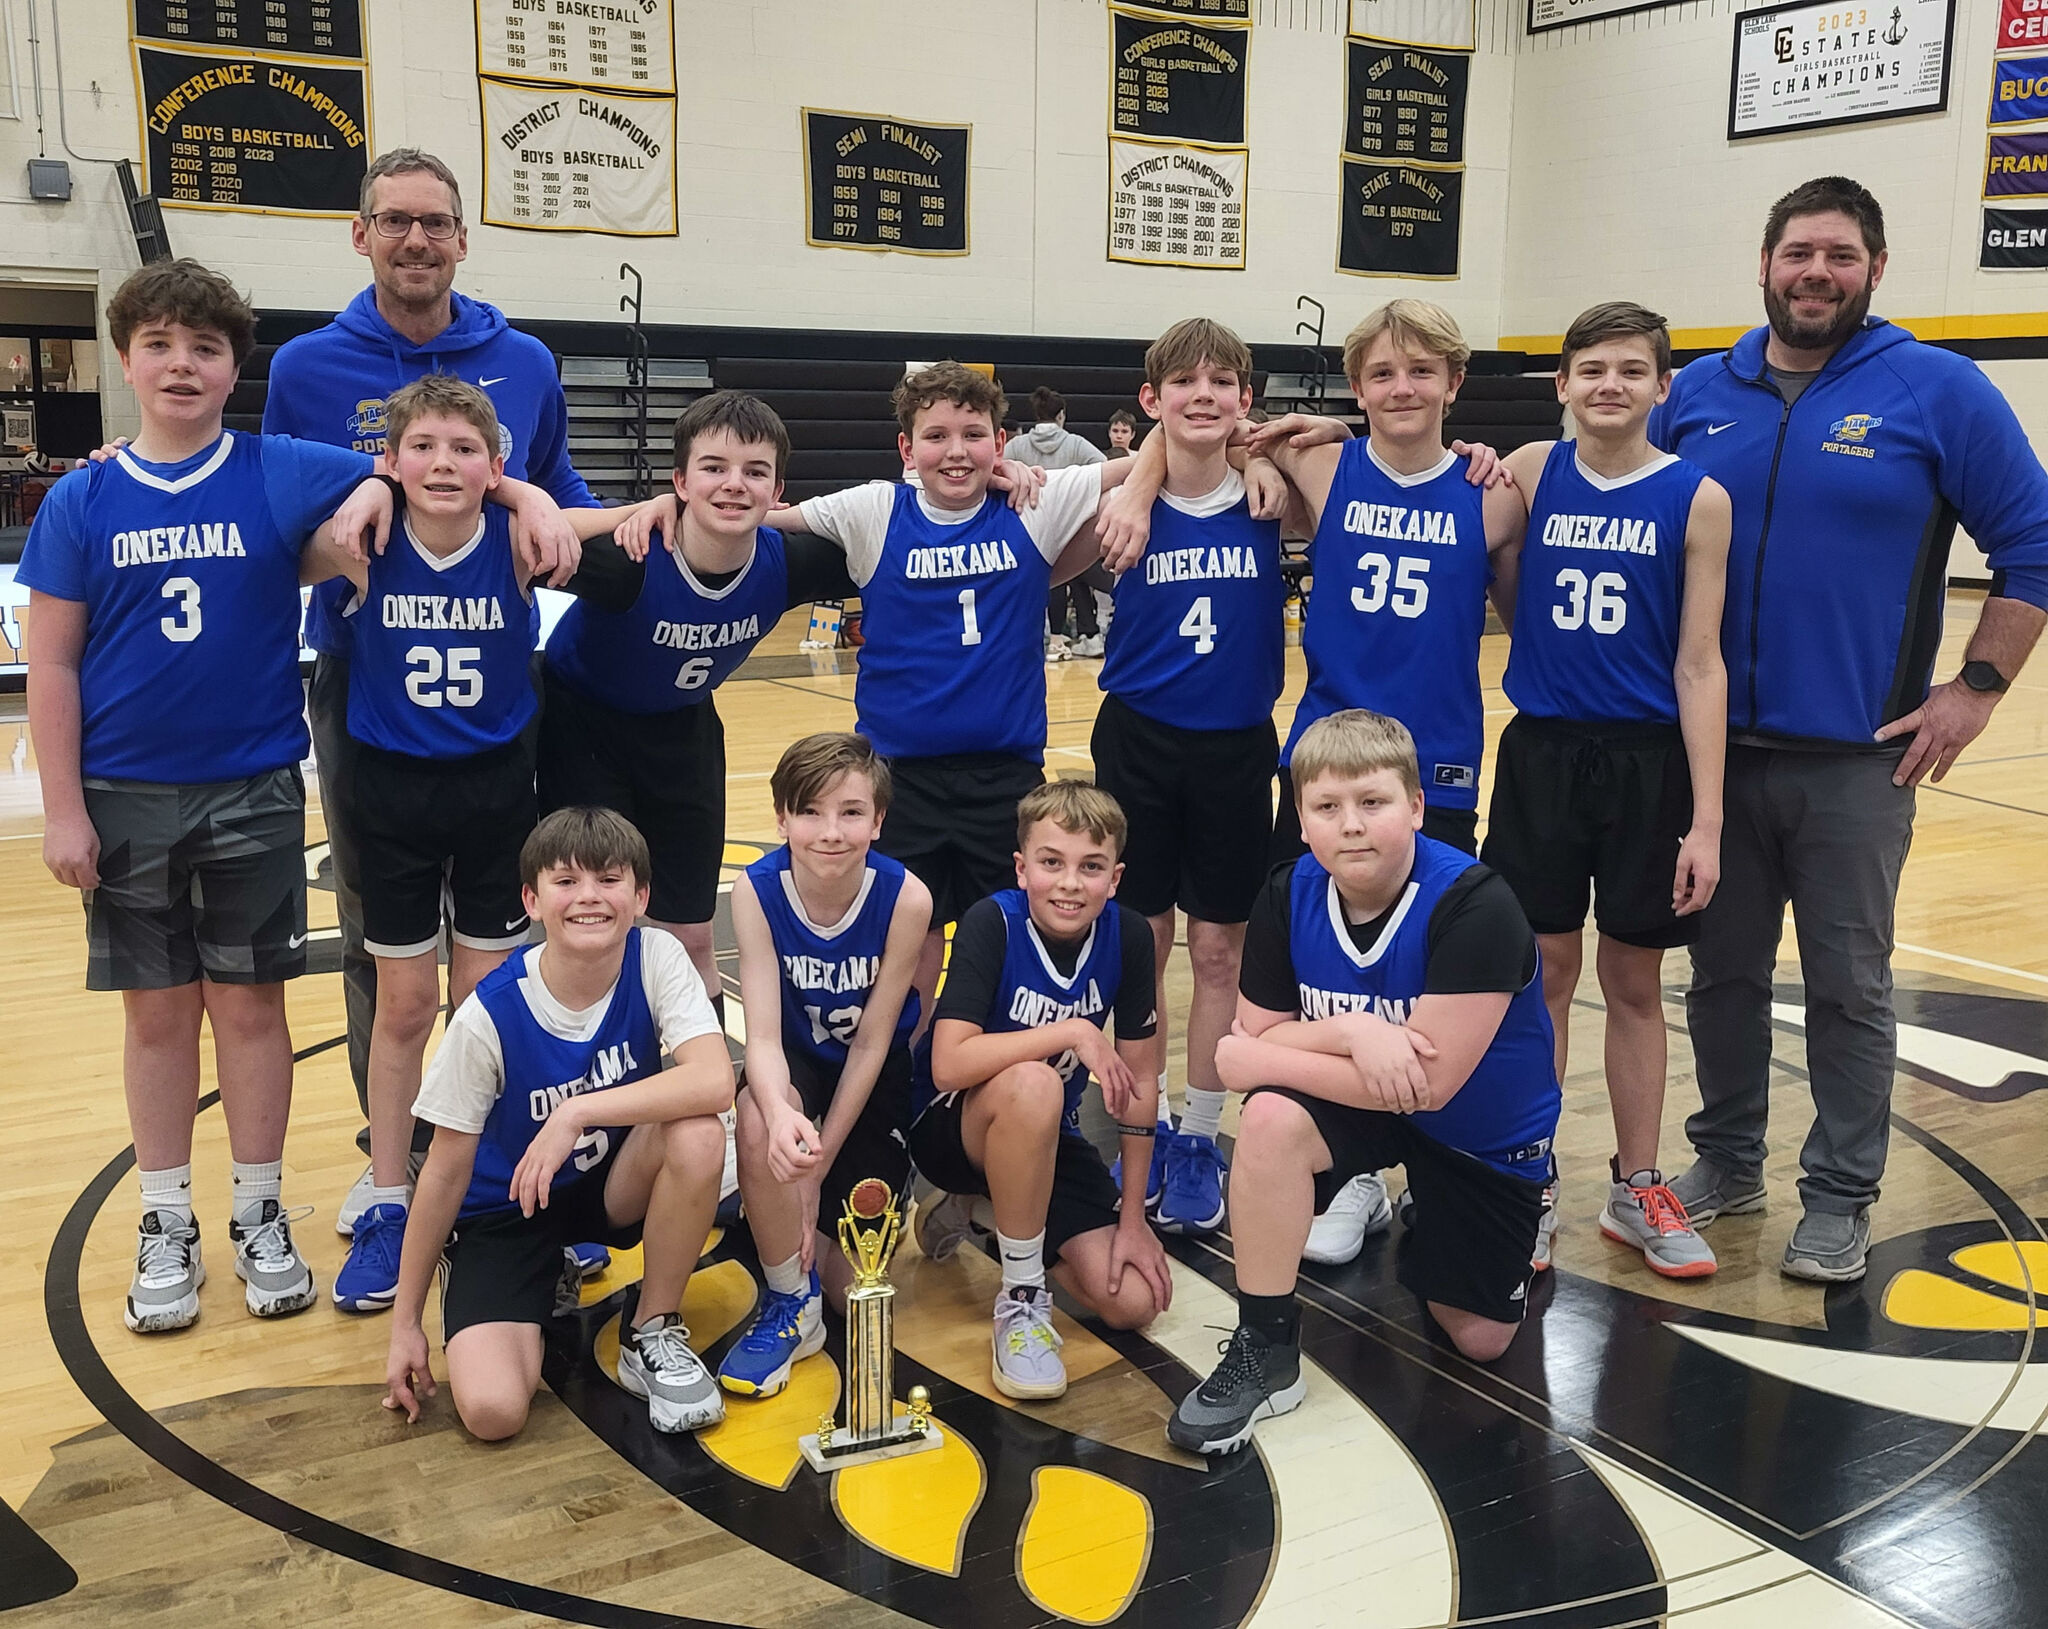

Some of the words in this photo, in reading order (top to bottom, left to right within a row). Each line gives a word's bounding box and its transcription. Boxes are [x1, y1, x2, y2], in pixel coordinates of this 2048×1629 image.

[265, 2, 286, 14] 1978
[513, 0, 545, 12] BOYS
[557, 1, 639, 23] BASKETBALL
[1226, 0, 1245, 12] 2016
[167, 7, 187, 19] 1959
[266, 16, 286, 28] 1980
[506, 16, 523, 27] 1957
[548, 21, 564, 31] 1964
[589, 26, 606, 36] 1977
[630, 30, 646, 40] 1984
[1745, 18, 1759, 27] GLEN
[1761, 15, 1776, 24] LAKE
[1818, 10, 1867, 32] 2023
[167, 23, 189, 34] 1960
[217, 27, 237, 38] 1976
[267, 32, 287, 43] 1983
[315, 36, 333, 47] 1994
[1745, 24, 1770, 35] SCHOOLS
[507, 30, 525, 40] 1958
[548, 35, 565, 44] 1965
[590, 40, 606, 50] 1978
[631, 44, 647, 53] 1985
[1124, 30, 1191, 63] CONFERENCE
[1193, 34, 1238, 73] CHAMPS
[1802, 29, 1876, 56] STATE
[507, 44, 525, 54] 1959
[549, 48, 566, 58] 1975
[590, 53, 607, 63] 1980
[631, 57, 647, 66] 1986
[1141, 57, 1166, 69] GIRLS
[1168, 59, 1222, 73] BASKETBALL
[1794, 61, 1819, 73] GIRLS
[1823, 51, 1881, 68] BASKETBALL
[508, 58, 526, 68] 1960
[550, 62, 567, 71] 1976
[592, 67, 607, 76] 1981
[632, 71, 648, 79] 1990
[1118, 67, 1139, 81] 2017
[1146, 71, 1167, 84] 2022
[1368, 56, 1392, 81] SEMI
[1404, 53, 1449, 88] FINALIST
[1773, 61, 1900, 96] CHAMPIONS
[1118, 82, 1139, 95] 2019
[1146, 86, 1168, 98] 2023
[1366, 88, 1392, 101] GIRLS
[1397, 90, 1448, 106] BASKETBALL
[149, 65, 255, 135] CONFERENCE
[268, 68, 364, 148] CHAMPIONS
[1118, 97, 1139, 111] 2020
[1147, 100, 1169, 113] 2024
[1363, 105, 1381, 118] 1977
[1398, 108, 1417, 119] 1990
[1431, 112, 1447, 124] 2017
[501, 101, 561, 151] DISTRICT
[579, 99, 661, 159] CHAMPIONS
[1118, 113, 1139, 126] 2021
[1364, 121, 1382, 134] 1978
[1398, 124, 1415, 135] 1994
[182, 125, 224, 142] BOYS
[232, 129, 334, 149] BASKETBALL
[836, 126, 868, 158] SEMI
[881, 125, 942, 166] FINALIST
[1363, 137, 1381, 150] 1979
[1430, 142, 1448, 152] 2023
[172, 143, 200, 156] 1995
[209, 146, 235, 158] 2018
[244, 149, 274, 161] 2023
[521, 150, 553, 164] BOYS
[564, 151, 644, 169] BASKETBALL
[171, 158, 203, 171] 2002
[211, 162, 237, 174] 2019
[1990, 155, 2048, 174] FRAN
[171, 173, 197, 185] 2011
[211, 177, 242, 189] 2020
[514, 170, 528, 179] 1991
[541, 173, 559, 181] 2000
[572, 173, 588, 182] 2018
[837, 165, 866, 180] BOYS
[873, 168, 941, 188] BASKETBALL
[1121, 156, 1169, 188] DISTRICT
[1173, 155, 1234, 198] CHAMPIONS
[1361, 172, 1391, 199] STATE
[1399, 169, 1445, 204] FINALIST
[172, 188, 200, 200] 2013
[212, 191, 239, 203] 2021
[514, 183, 529, 192] 1994
[543, 185, 561, 194] 2002
[573, 187, 589, 196] 2021
[834, 186, 858, 199] 1959
[880, 189, 900, 204] 1981
[920, 196, 944, 209] 1996
[1137, 181, 1162, 192] GIRLS
[1165, 184, 1219, 198] BASKETBALL
[543, 198, 558, 206] 2013
[573, 200, 590, 209] 2024
[1115, 192, 1136, 205] 1976
[1142, 195, 1163, 207] 1988
[1169, 198, 1189, 209] 1994
[1195, 201, 1215, 213] 1999
[1362, 205, 1385, 217] GIRLS
[1391, 207, 1441, 222] BASKETBALL
[542, 210, 558, 219] 2017
[834, 204, 858, 218] 1976
[878, 208, 901, 222] 1984
[922, 214, 944, 226] 2018
[1114, 207, 1136, 219] 1977
[1142, 210, 1163, 222] 1990
[1168, 213, 1188, 224] 1995
[1195, 216, 1215, 227] 2000
[1222, 218, 1240, 228] 2020
[833, 222, 857, 236] 1977
[879, 225, 900, 239] 1985
[1114, 222, 1135, 234] 1978
[1142, 225, 1162, 237] 1992
[1167, 227, 1187, 239] 1996
[1194, 231, 1214, 242] 2001
[1221, 232, 1239, 243] 2021
[1391, 222, 1413, 236] 1979
[1987, 228, 2046, 248] GLEN
[1113, 237, 1134, 249] 1979
[1141, 240, 1161, 252] 1993
[1167, 242, 1187, 254] 1998
[1194, 245, 1213, 256] 2017
[1220, 247, 1239, 257] 2022
[1821, 442, 1875, 458] PORTAGERS
[1343, 500, 1457, 545] ONEKAMA
[112, 522, 246, 568] ONEKAMA
[1542, 513, 1657, 556] ONEKAMA
[905, 539, 1018, 580] ONEKAMA
[1146, 546, 1258, 585] ONEKAMA
[1350, 552, 1431, 619] 35
[161, 576, 202, 642] 3
[382, 594, 504, 630] ONEKAMA
[1551, 567, 1627, 635] 36
[958, 589, 981, 646] 1
[1179, 596, 1217, 654] 4
[652, 614, 760, 651] ONEKAMA
[405, 645, 483, 708] 25
[674, 657, 715, 691] 6
[804, 1004, 864, 1045] 12
[573, 1129, 609, 1173] 5
